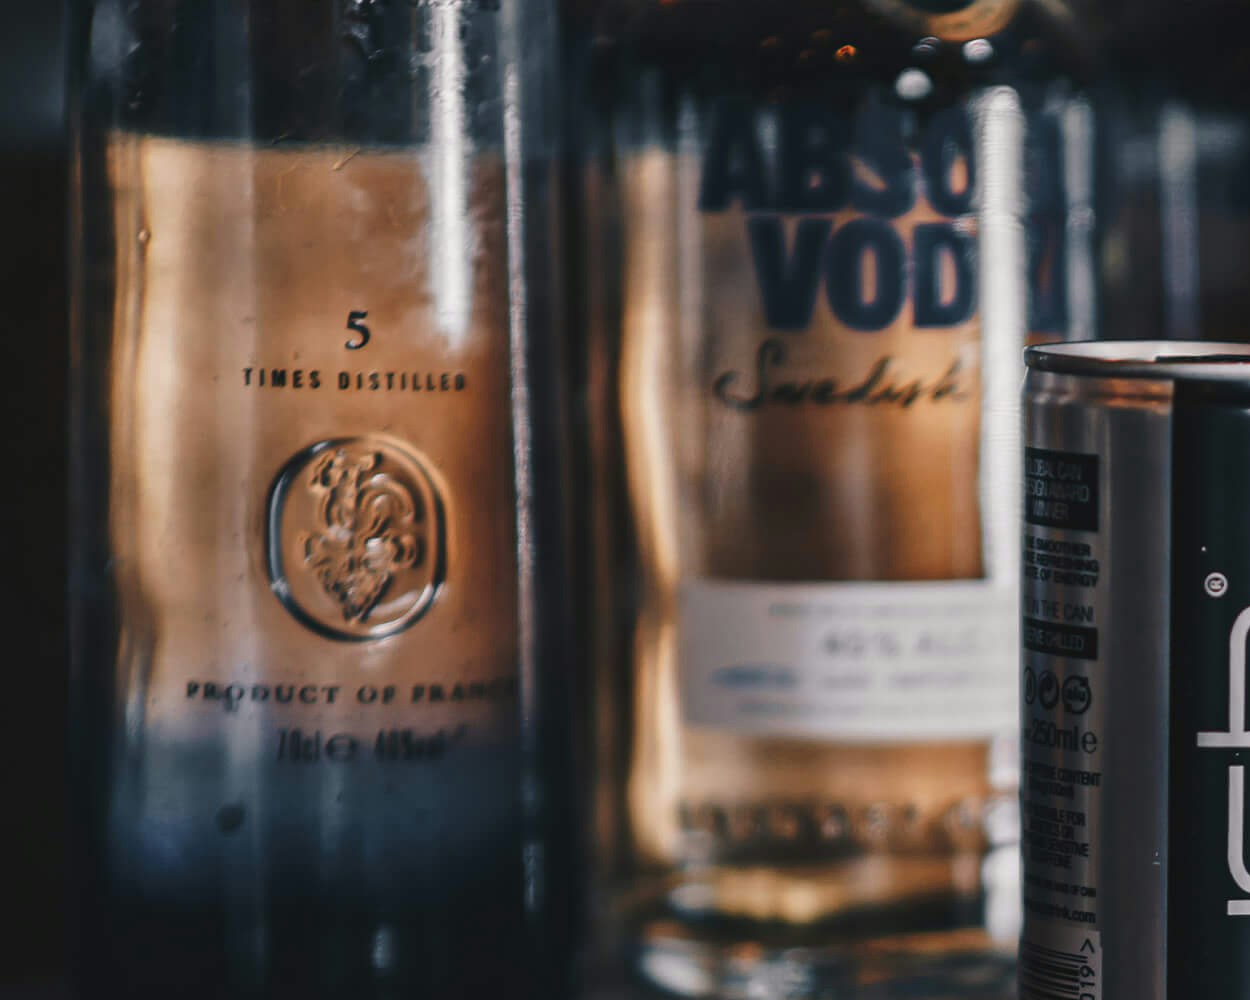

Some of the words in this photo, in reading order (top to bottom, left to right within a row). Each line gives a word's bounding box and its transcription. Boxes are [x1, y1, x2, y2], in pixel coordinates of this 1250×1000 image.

[346, 310, 371, 350] 5
[242, 367, 323, 391] TIMES
[338, 371, 468, 393] DISTILLED
[186, 680, 341, 707] PRODUCT
[356, 682, 397, 705] OF
[411, 682, 513, 704] FRAN
